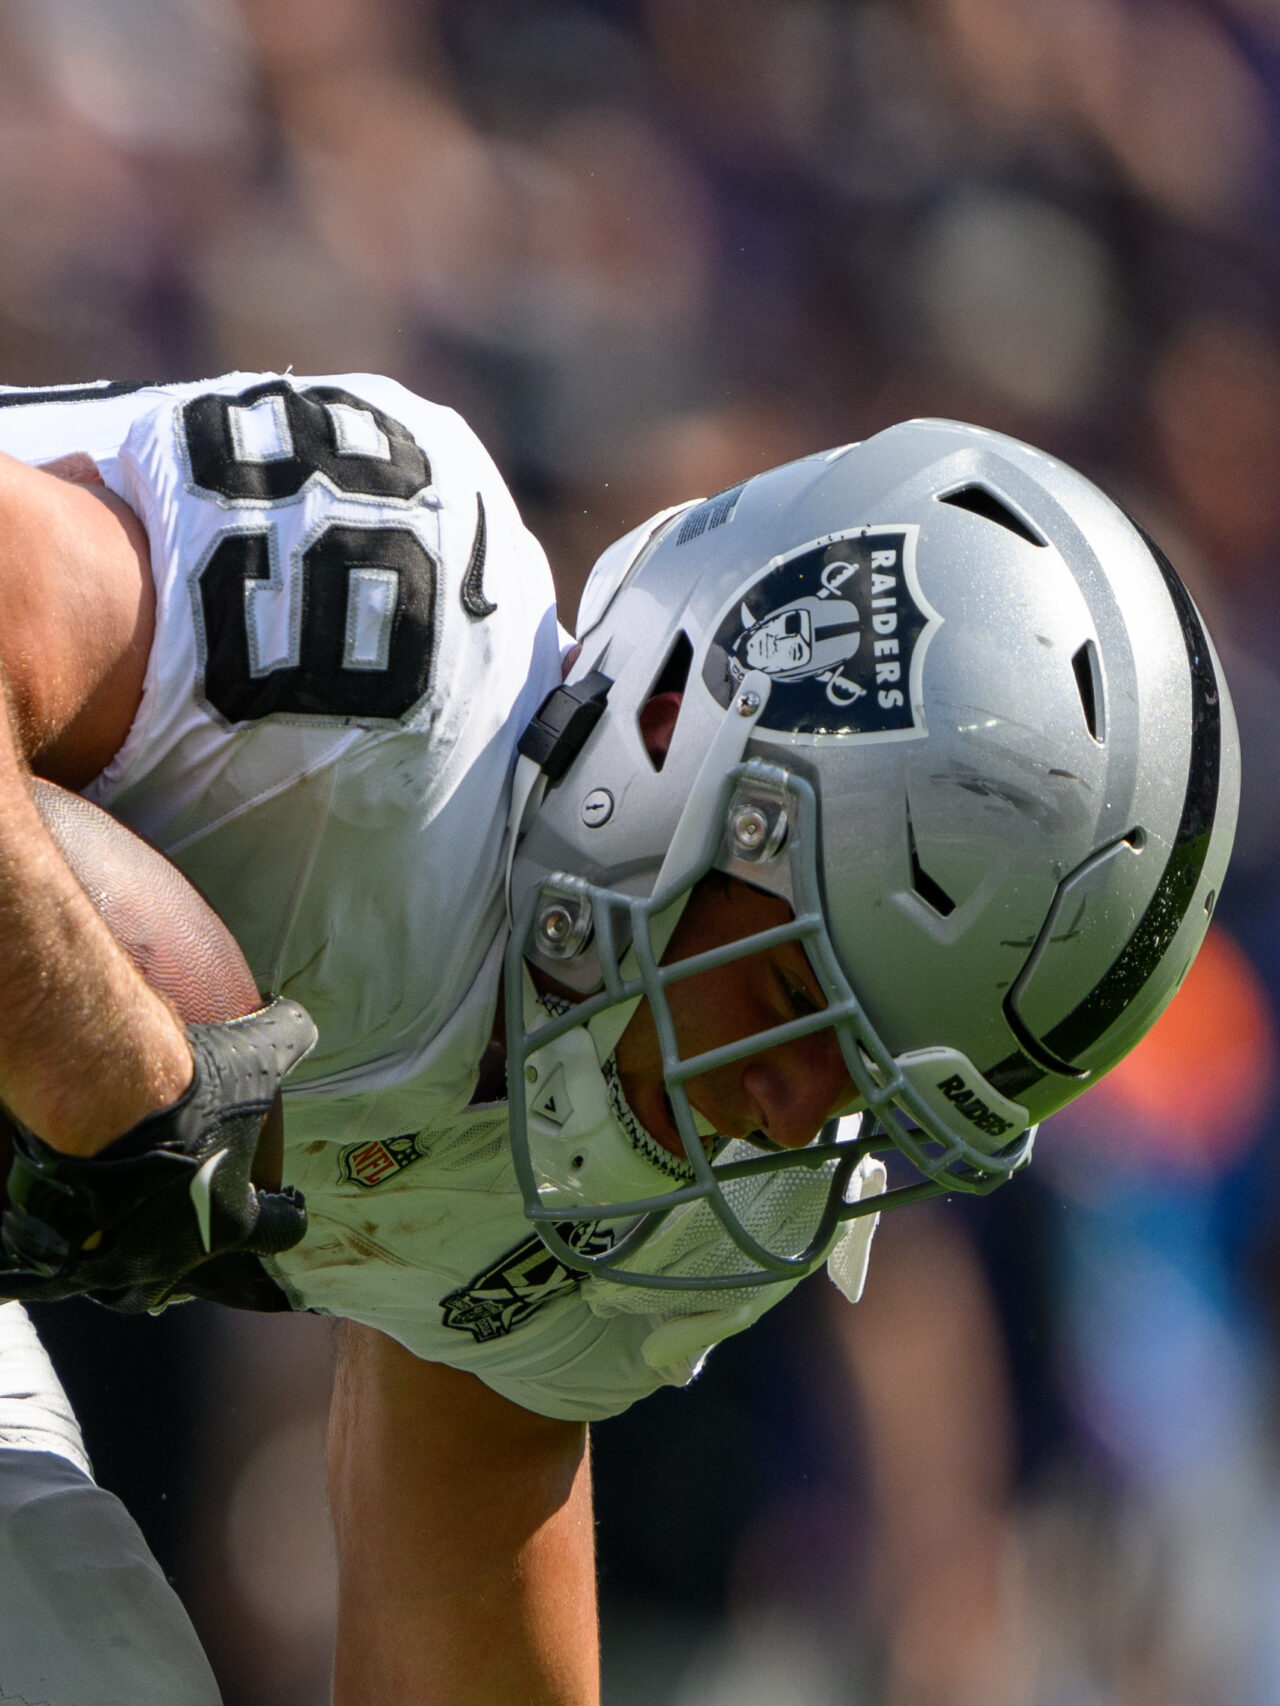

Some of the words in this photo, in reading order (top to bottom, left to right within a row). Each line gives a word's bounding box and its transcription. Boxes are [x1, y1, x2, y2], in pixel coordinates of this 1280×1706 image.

[177, 378, 440, 730] 89
[871, 549, 904, 710] RAIDERS
[936, 1073, 1015, 1137] RAIDERS
[351, 1140, 396, 1184] NFL
